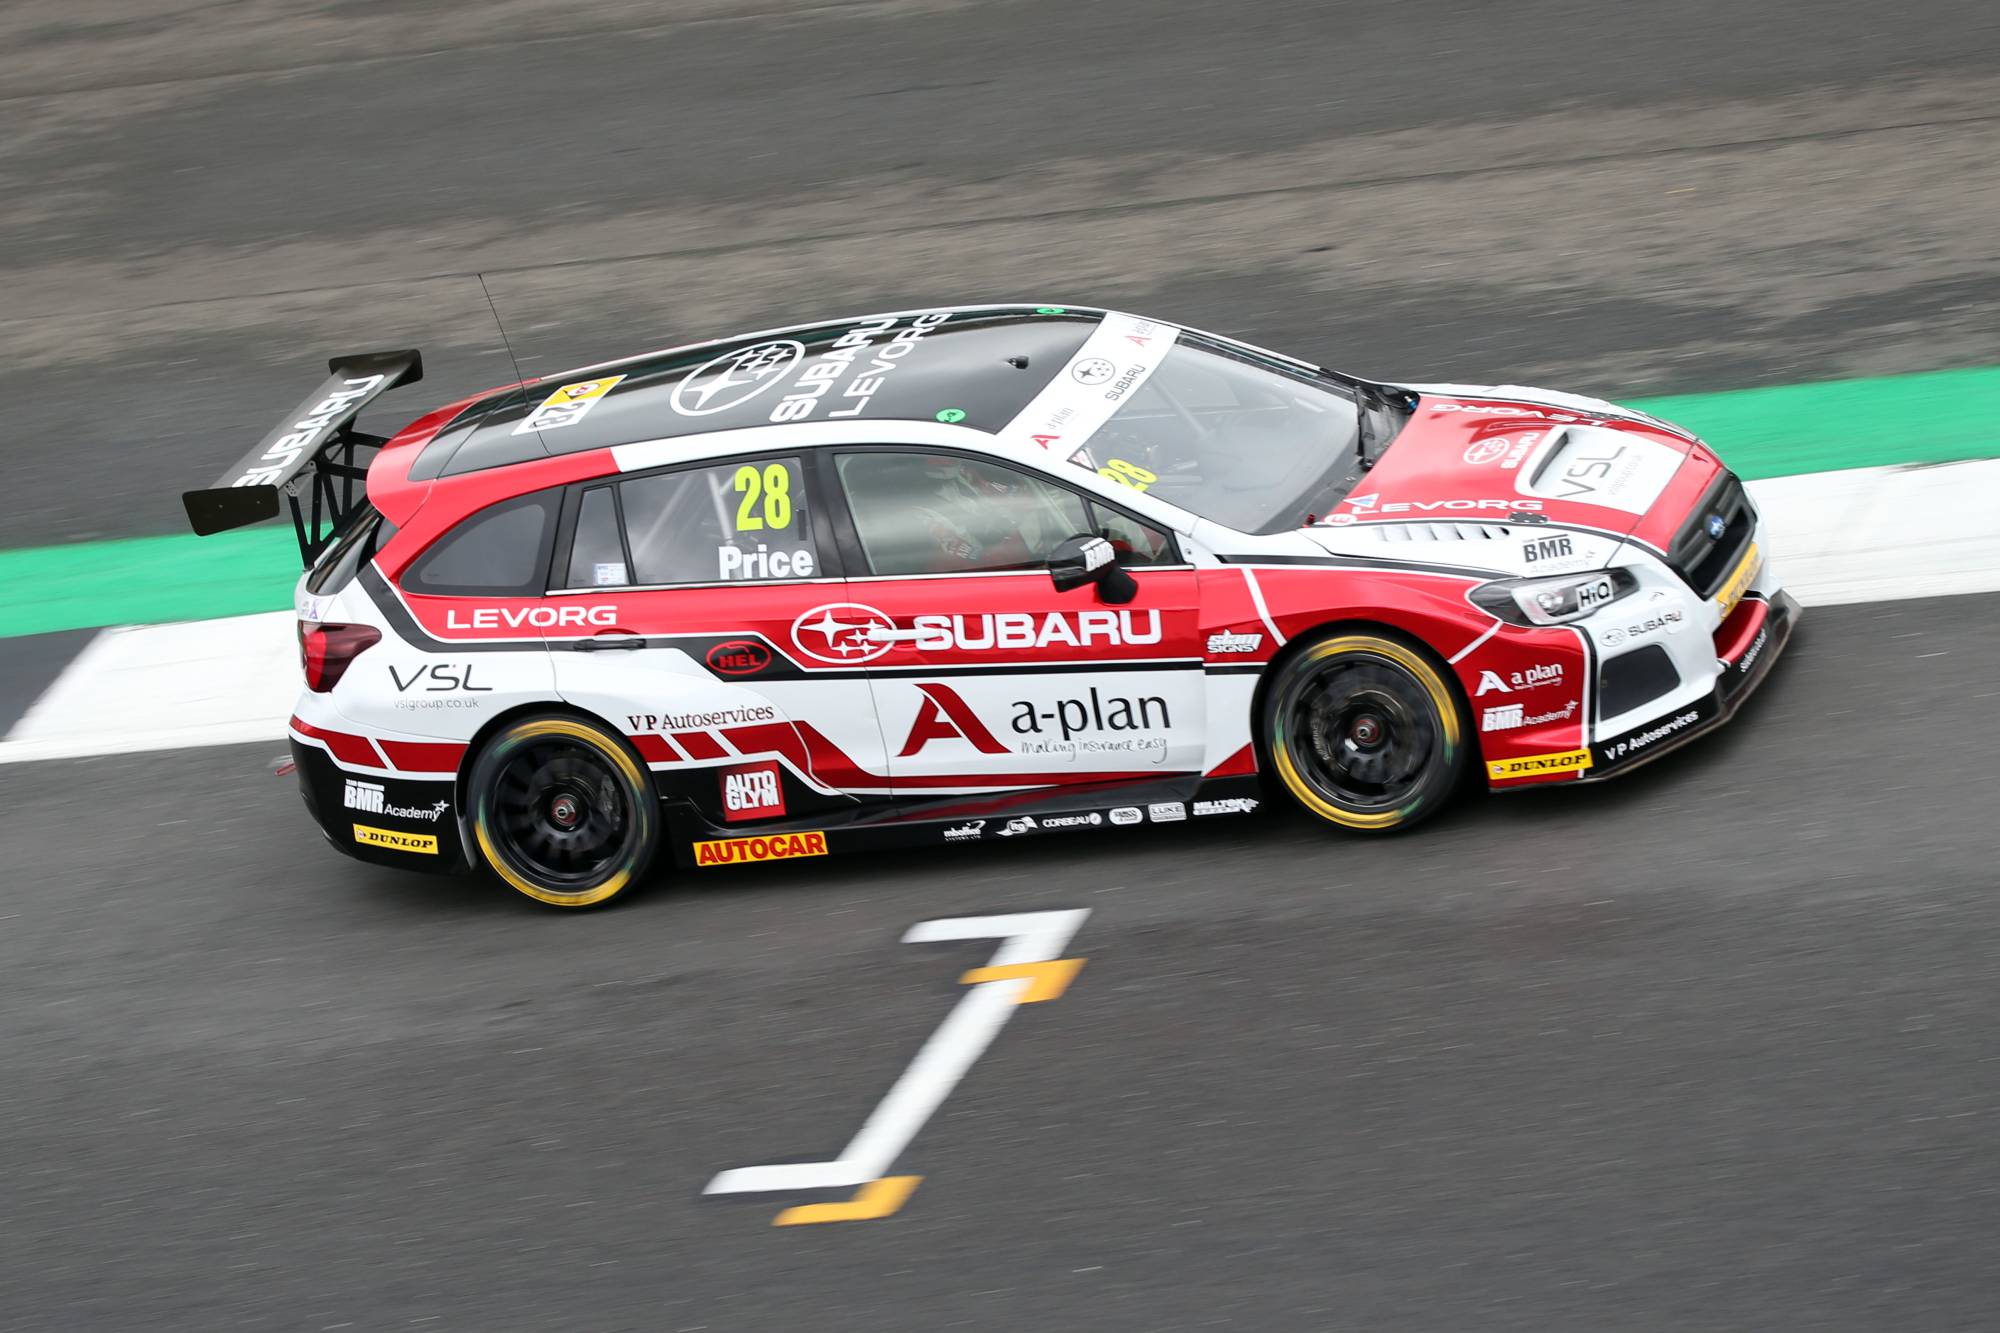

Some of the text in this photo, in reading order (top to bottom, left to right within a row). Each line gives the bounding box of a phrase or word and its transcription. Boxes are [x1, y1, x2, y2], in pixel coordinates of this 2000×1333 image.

[769, 318, 899, 422] SUBARU
[828, 313, 954, 417] LEVORG
[1105, 364, 1146, 401] SUBARU
[231, 374, 385, 488] SUBARU
[1098, 458, 1158, 492] 28
[1556, 446, 1627, 497] VSL
[734, 463, 792, 532] 28
[1351, 500, 1543, 515] LEVORG
[718, 544, 814, 580] Price
[1523, 538, 1572, 563] BMR
[447, 605, 618, 629] LEVORG
[913, 609, 1162, 650] SUBARU
[1628, 611, 1682, 637] SUBARU
[720, 654, 761, 668] HEL
[388, 664, 493, 692] VSL
[662, 705, 774, 730] Autoservices
[896, 683, 1171, 757] A a-plan
[1137, 738, 1168, 764] easy
[1510, 754, 1587, 772] DUNLOP
[726, 771, 776, 793] AUTO
[344, 785, 441, 822] BMR Academy
[726, 787, 780, 811] GLYM
[369, 832, 433, 848] DUNLOP
[700, 833, 825, 865] AUTOCAR
